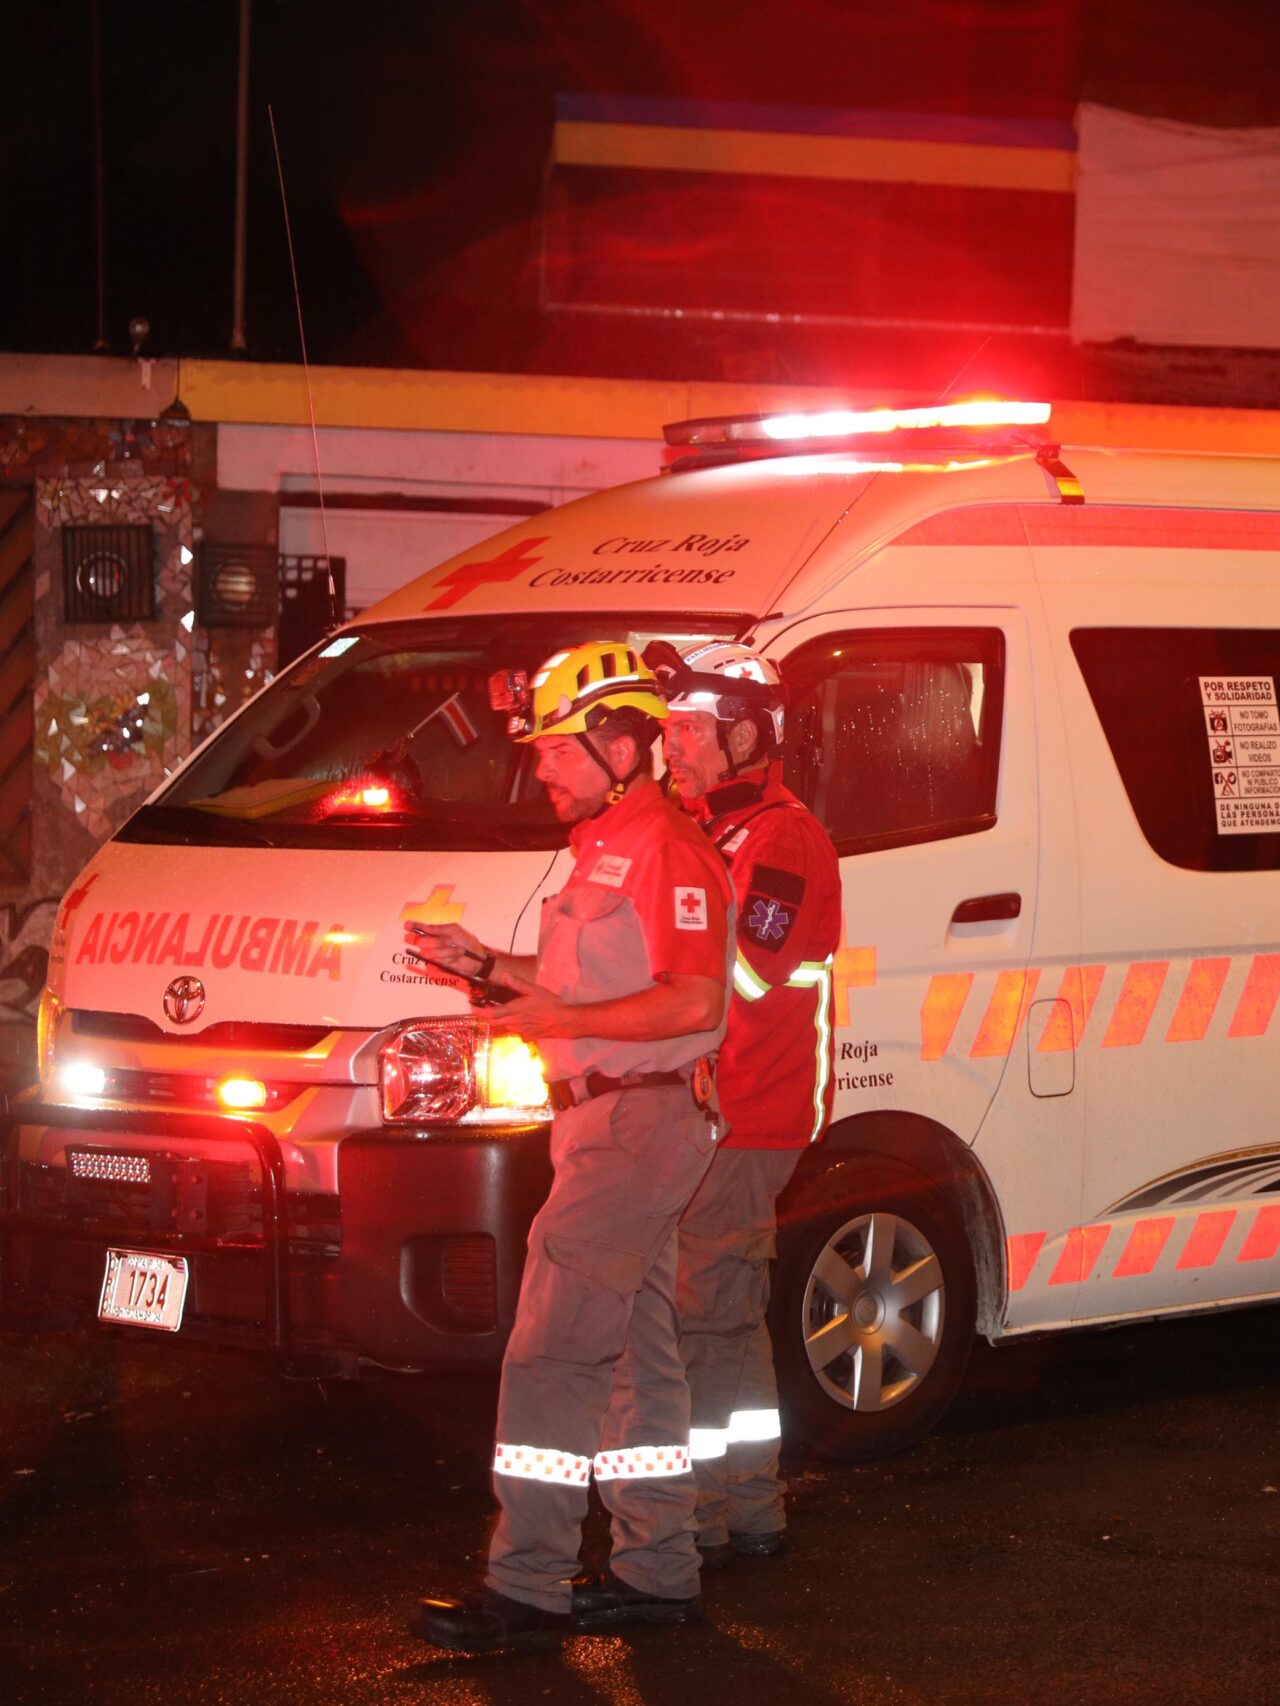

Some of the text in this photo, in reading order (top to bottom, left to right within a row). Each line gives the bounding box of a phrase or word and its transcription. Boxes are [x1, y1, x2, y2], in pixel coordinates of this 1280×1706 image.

[592, 534, 750, 557] Cruz Roja
[528, 564, 736, 588] Costarricense
[1203, 681, 1271, 691] POR RESPETO
[1206, 692, 1272, 701] Y SOLIDARIDAD
[1239, 710, 1269, 719] NO TOMO
[1239, 740, 1277, 750] NO REALIZO
[1248, 753, 1272, 762] VIDEOS
[1241, 770, 1250, 778] NO
[1220, 803, 1231, 811] DE
[1234, 802, 1272, 810] NINGUNA
[1220, 811, 1237, 819] LAS
[392, 952, 422, 966] Cruz
[380, 969, 460, 987] Costarricense
[840, 1040, 878, 1063] Roja
[837, 1072, 894, 1091] ricense
[129, 1270, 170, 1309] 1734
